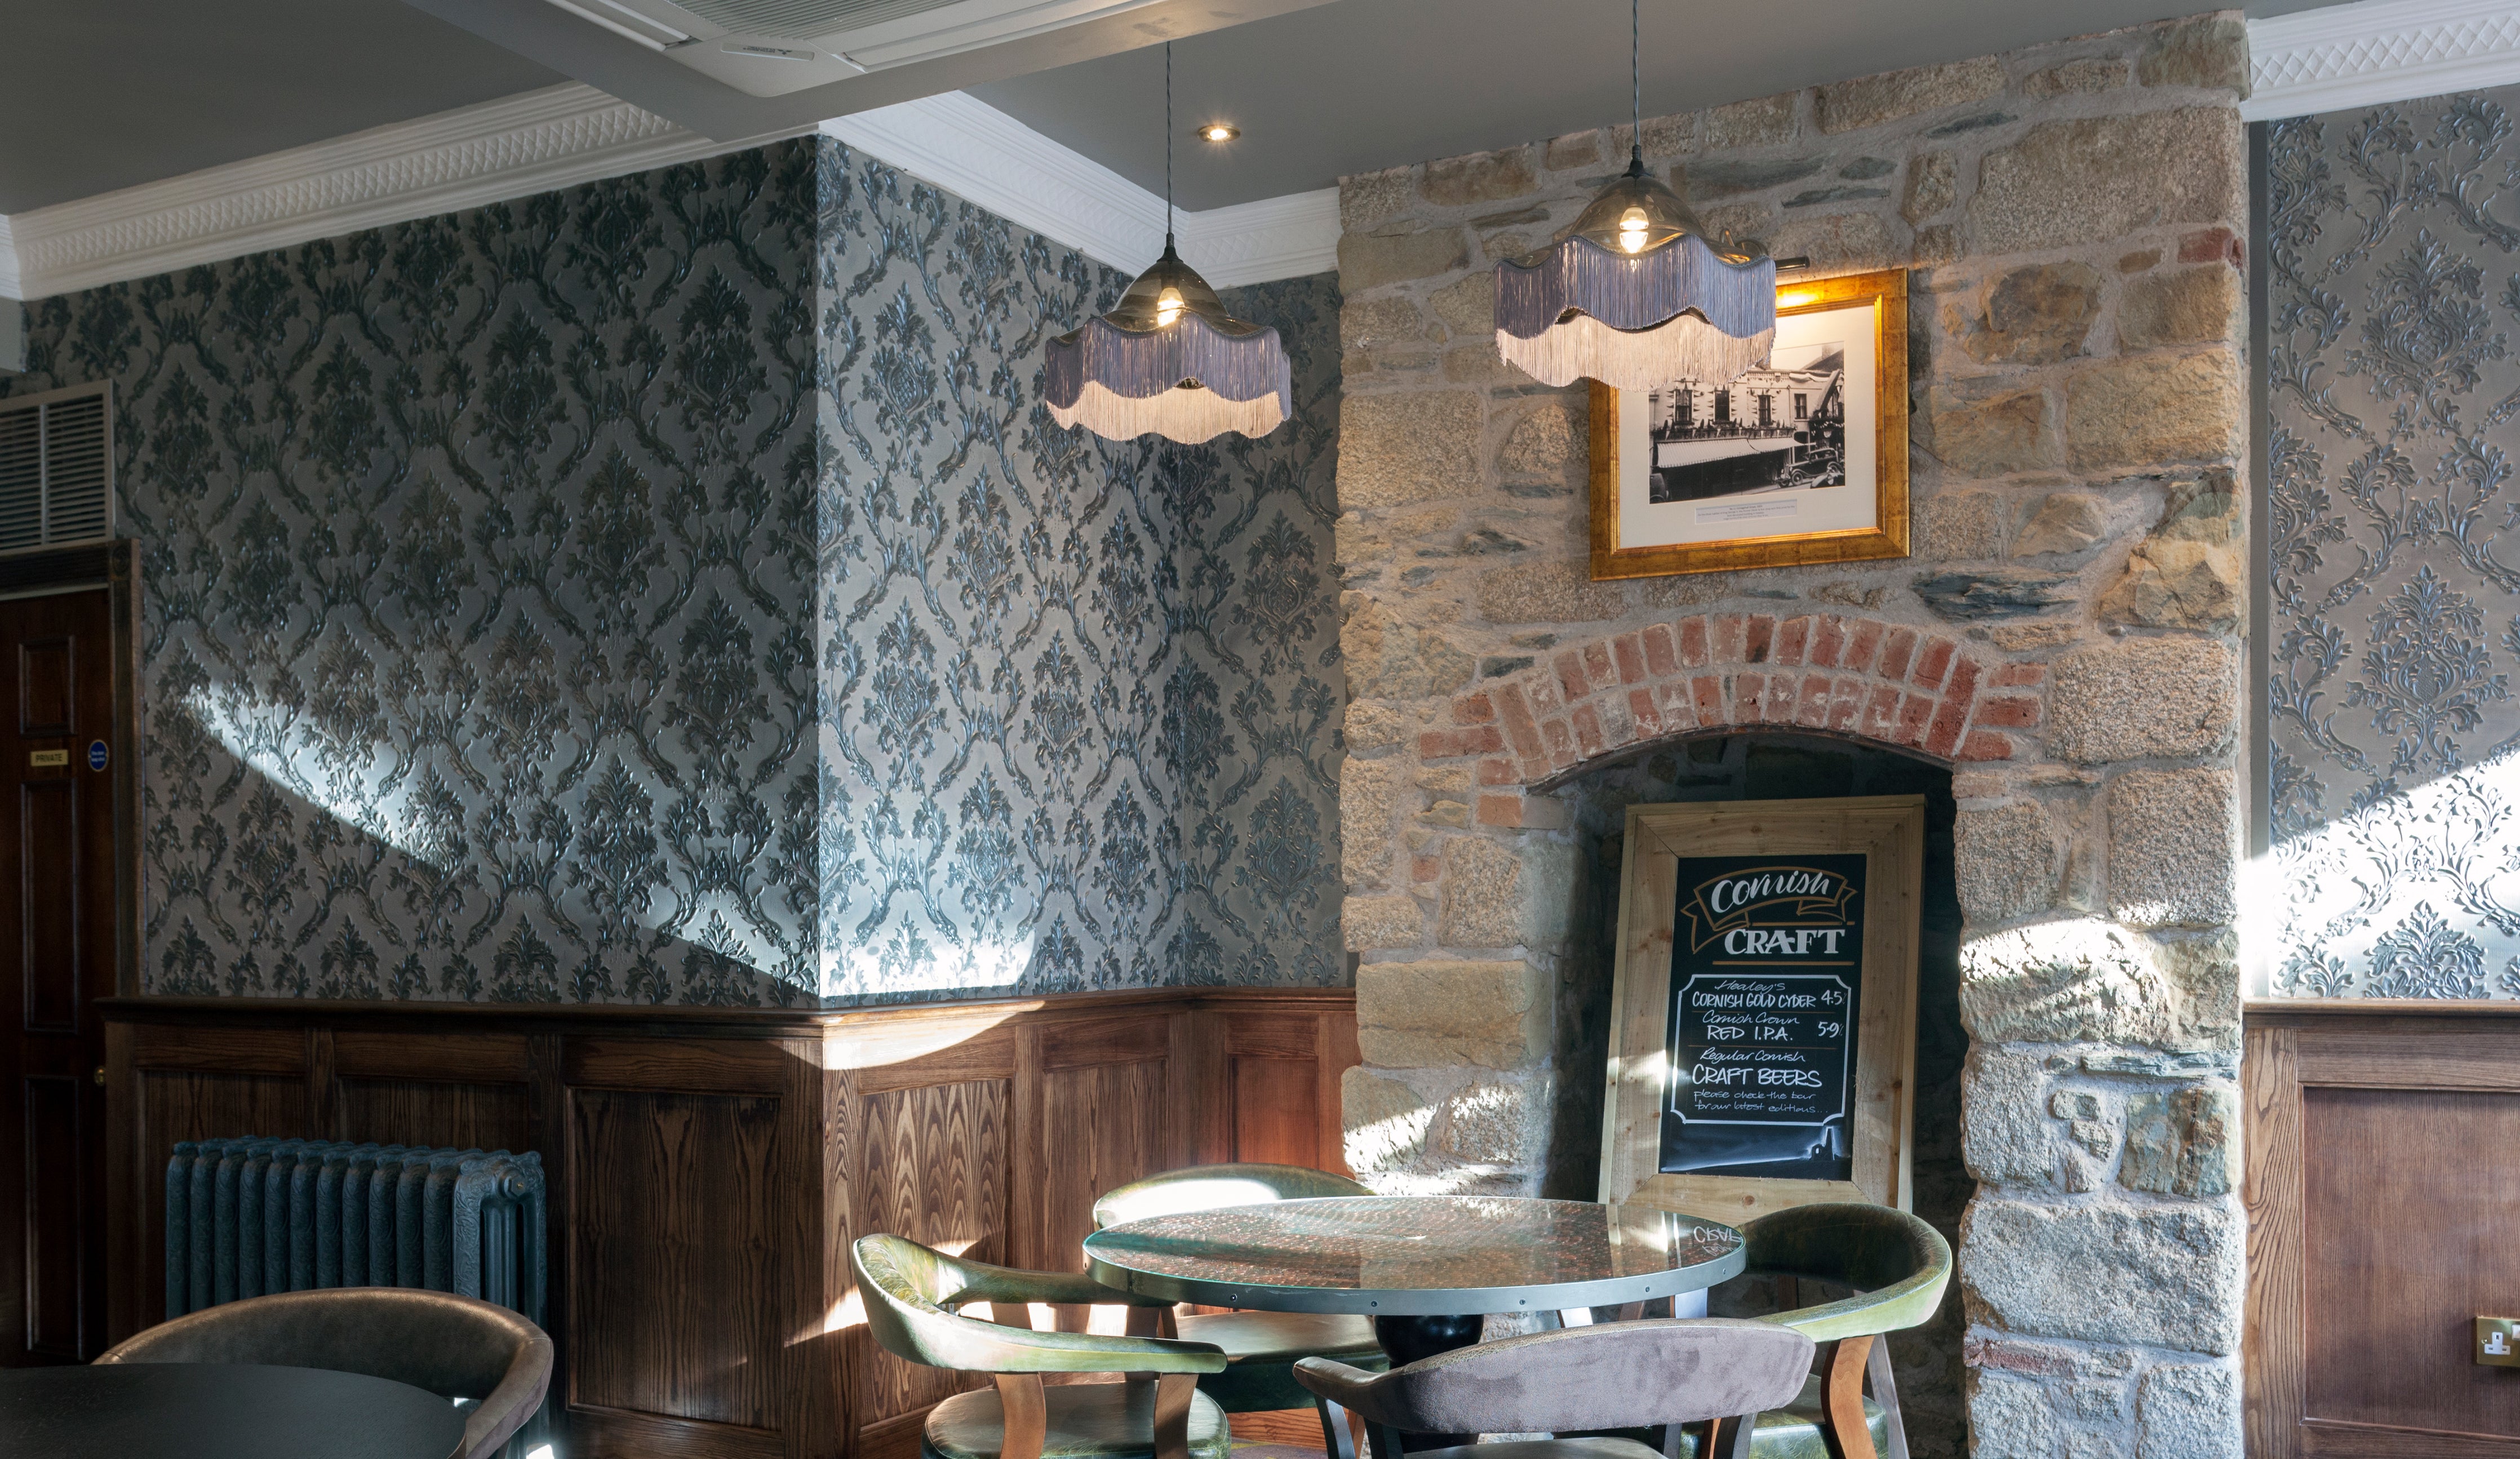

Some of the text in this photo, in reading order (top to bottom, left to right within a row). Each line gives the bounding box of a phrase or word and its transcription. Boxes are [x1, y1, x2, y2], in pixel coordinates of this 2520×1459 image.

[36, 753, 63, 762] PRIVATE
[1711, 870, 1830, 913] Cornish
[1724, 928, 1845, 954] CRAFT
[1715, 980, 1786, 994] Healey's
[1692, 991, 1742, 1007] CORNISH
[1746, 993, 1776, 1007] GOLD
[1778, 994, 1817, 1008] CYDER
[1702, 1010, 1800, 1024] Cornish Crown
[1707, 1025, 1745, 1040] RED
[1755, 1026, 1793, 1041] I.P.A.
[1700, 1047, 1805, 1064] Regular Cornish
[1692, 1064, 1822, 1088] CRAFT BEERS
[1694, 1088, 1730, 1101] please
[1734, 1091, 1765, 1099] check
[1765, 1091, 1787, 1099] the
[1694, 1100, 1714, 1110] for
[1734, 1102, 1765, 1110] latest
